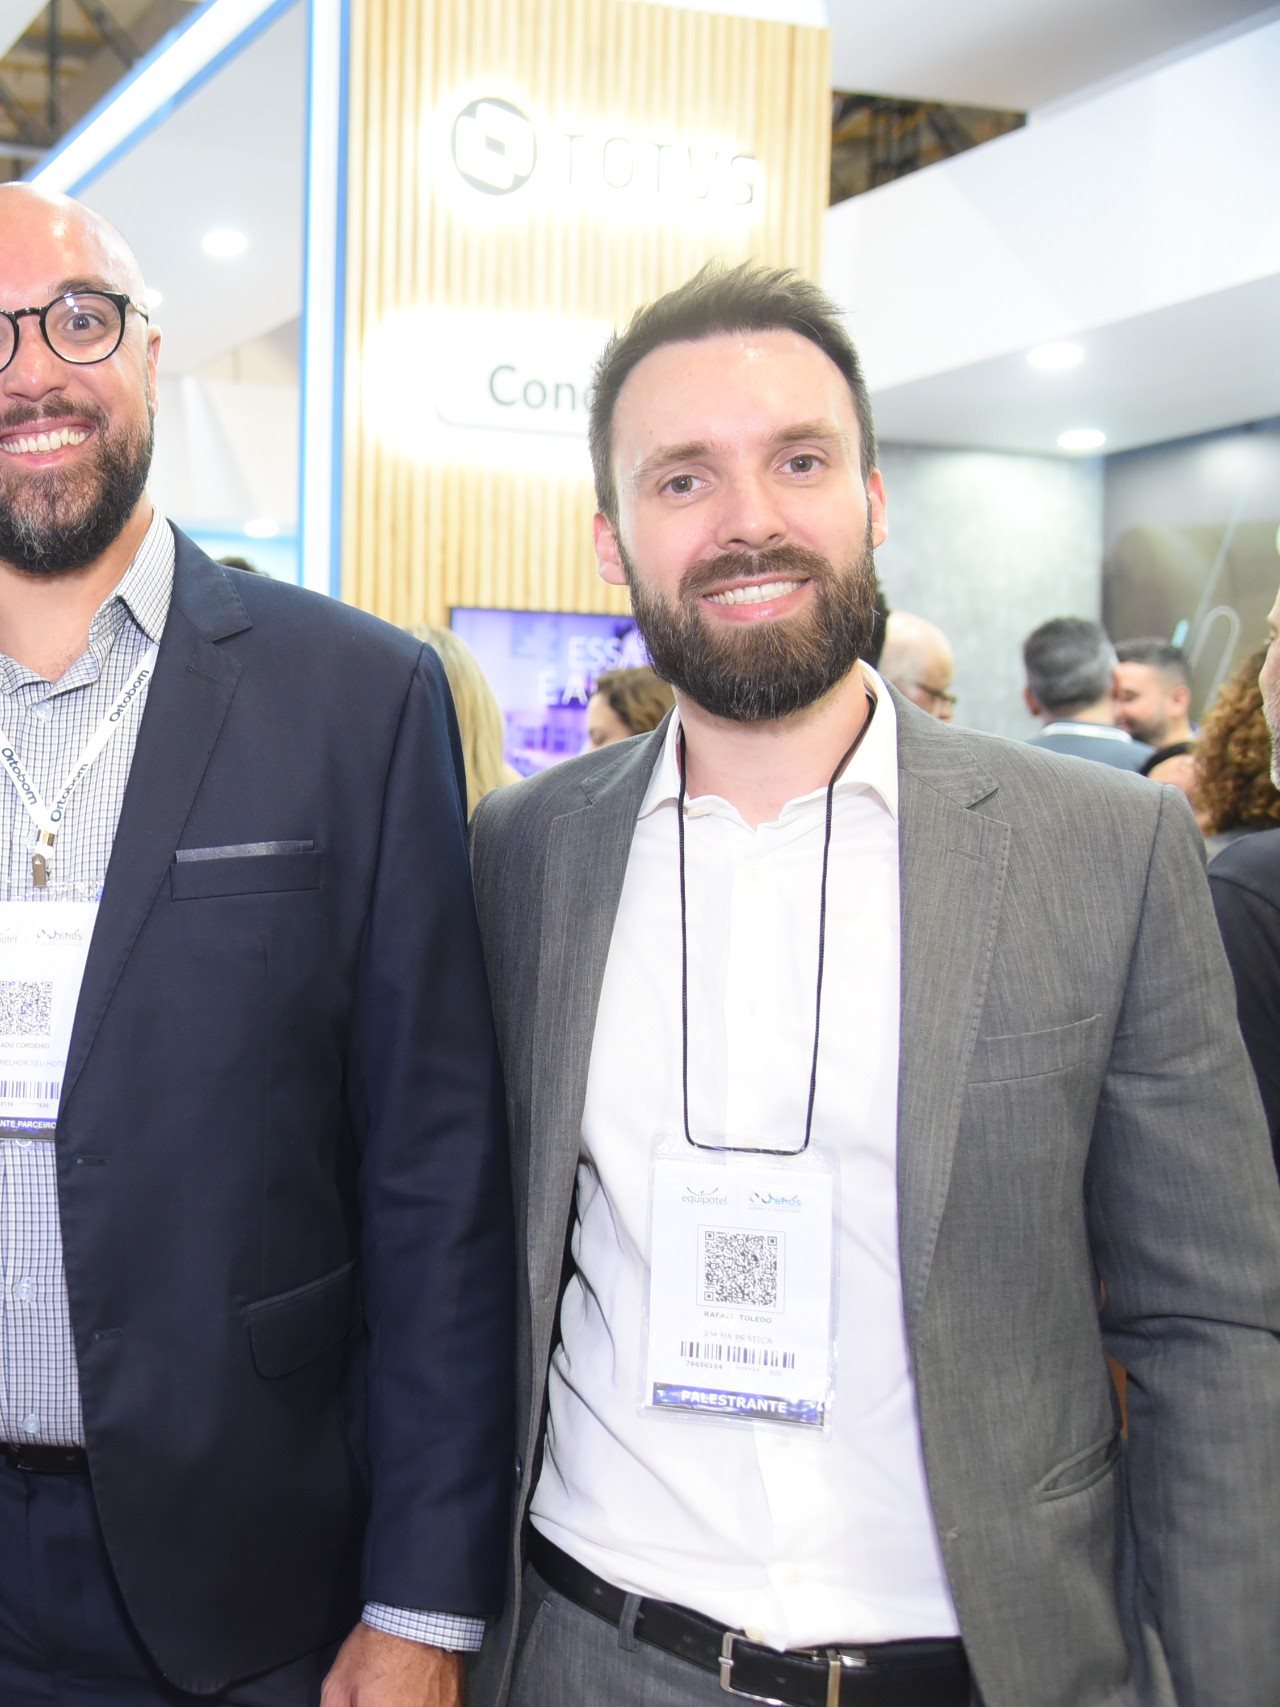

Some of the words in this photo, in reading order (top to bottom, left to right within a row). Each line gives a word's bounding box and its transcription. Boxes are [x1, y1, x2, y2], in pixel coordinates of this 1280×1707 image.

[109, 669, 150, 723] Ortobom
[1, 747, 38, 805] Ortobom
[51, 763, 89, 823] Ortobom
[681, 1192, 728, 1205] equipotel
[739, 1314, 773, 1324] TOLEDO
[680, 1389, 788, 1414] PALESTRANTE
